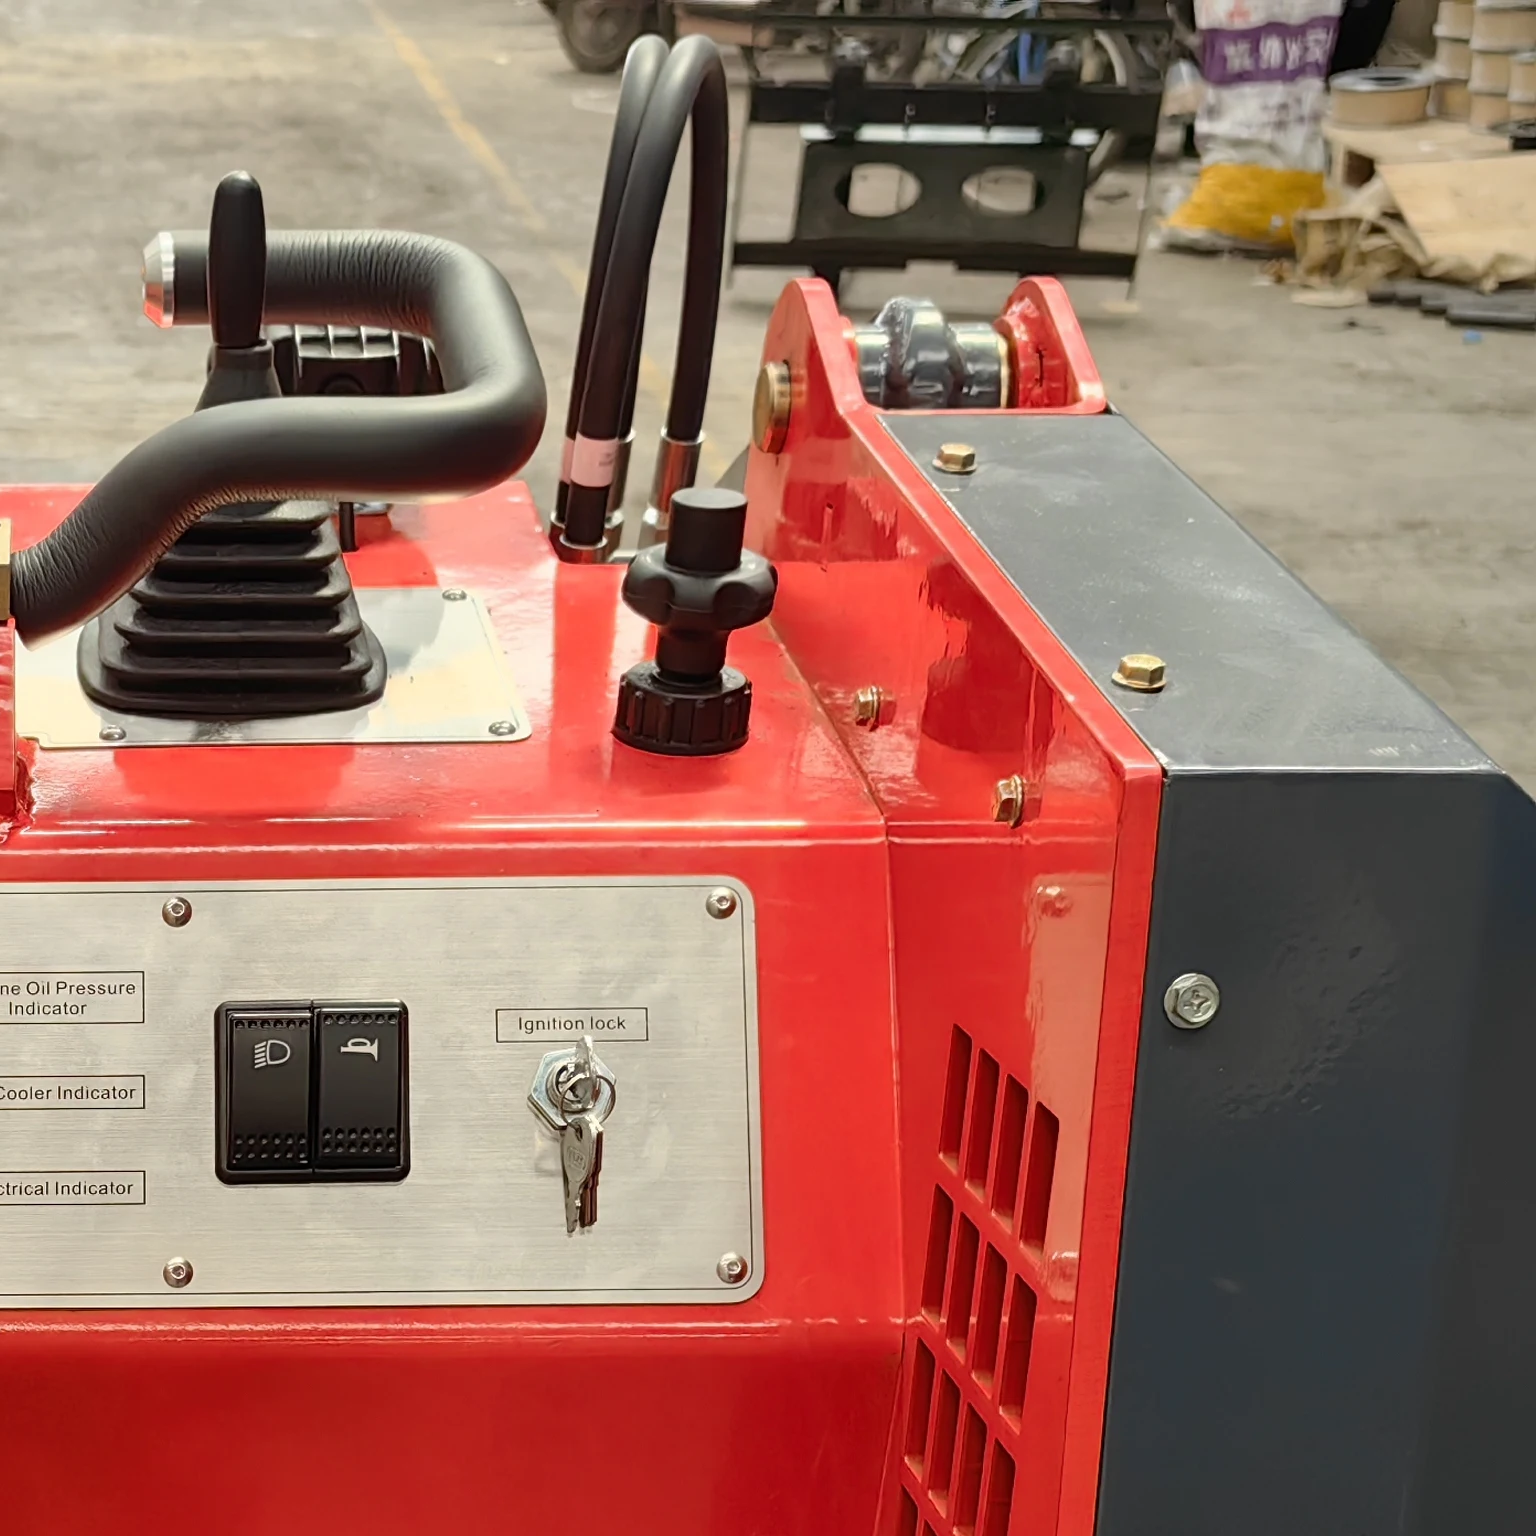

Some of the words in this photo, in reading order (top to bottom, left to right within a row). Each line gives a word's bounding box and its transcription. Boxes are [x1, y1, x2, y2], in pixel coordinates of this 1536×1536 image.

[26, 980, 50, 995] Oil
[56, 980, 136, 996] Pressure
[9, 1001, 87, 1016] Indicator
[518, 1016, 585, 1035] Ignition
[590, 1015, 626, 1030] lock
[57, 1085, 137, 1100] Indicator
[55, 1180, 134, 1196] Indicator
